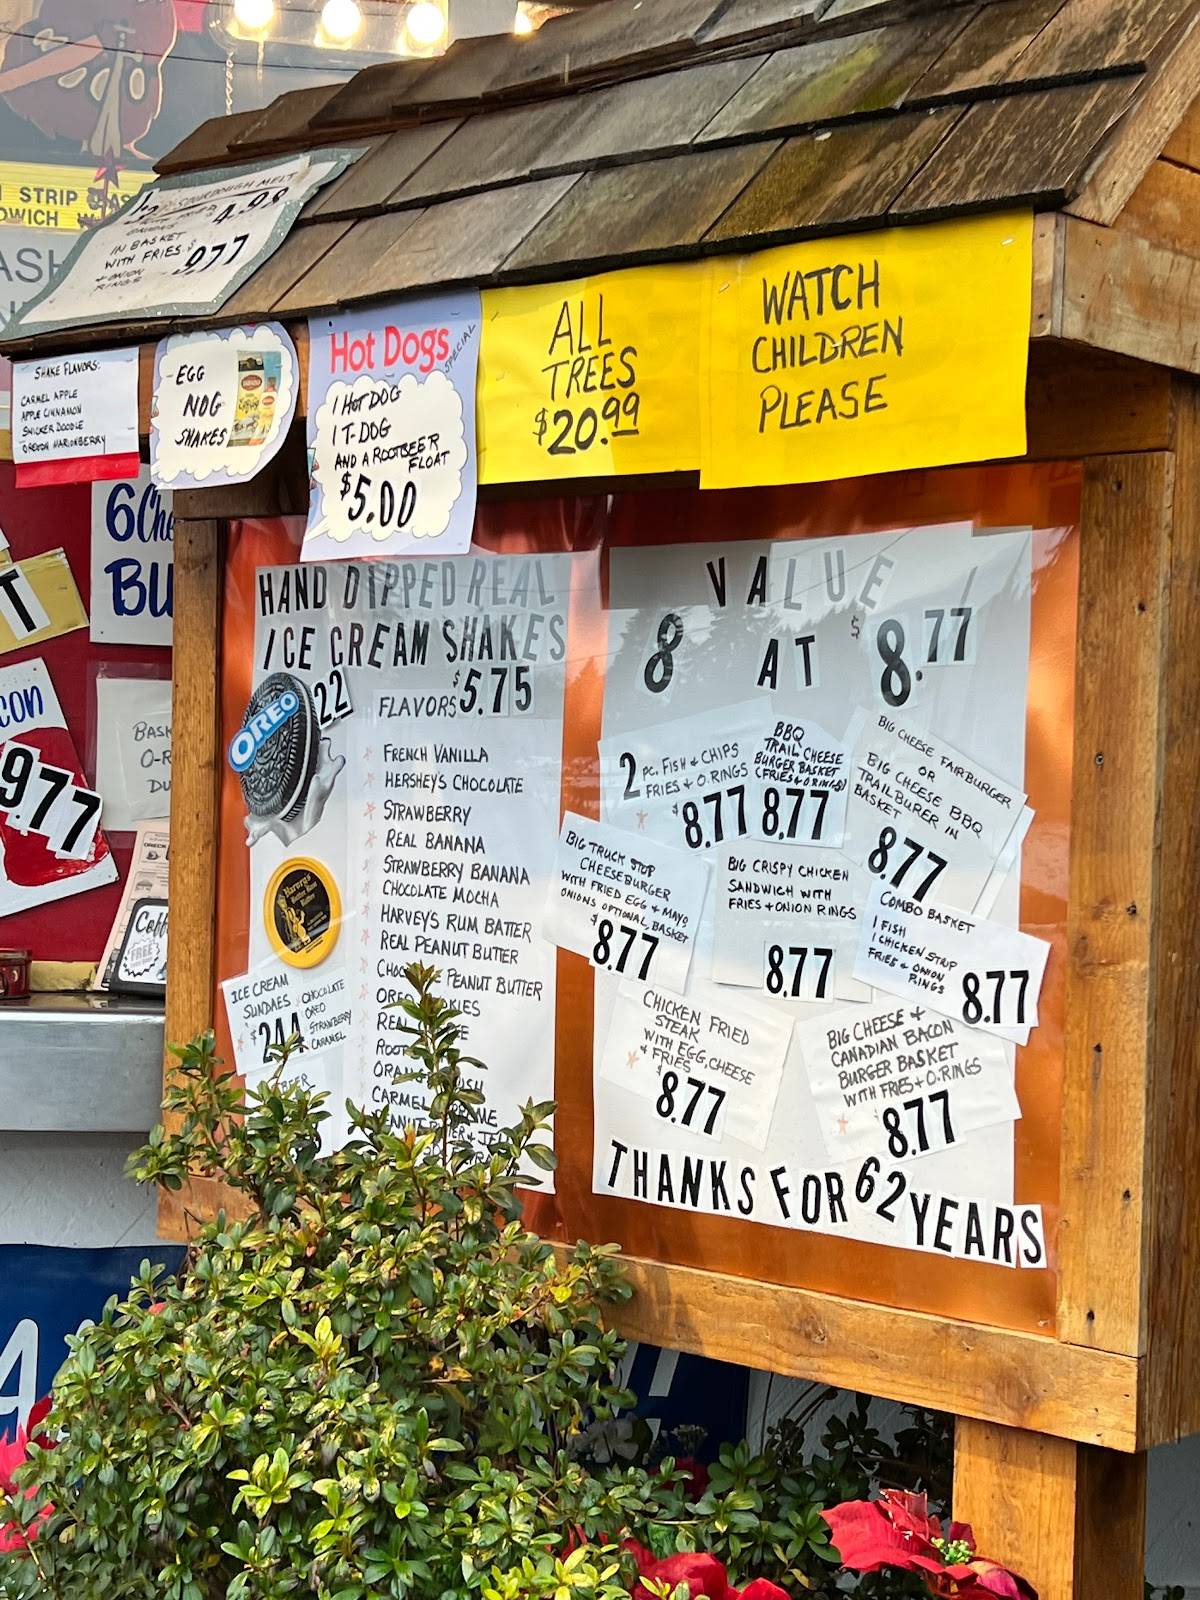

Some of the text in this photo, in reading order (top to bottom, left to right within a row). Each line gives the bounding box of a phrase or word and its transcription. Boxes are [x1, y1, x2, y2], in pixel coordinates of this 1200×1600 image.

[20, 187, 78, 206] STRIP
[105, 246, 181, 270] WITH FRIES
[110, 232, 187, 256] IN BASKET
[761, 260, 882, 327] WATCH
[548, 293, 613, 356] ALL
[330, 325, 450, 374] Hot Dogs
[444, 323, 477, 374] SPECIAL
[751, 315, 905, 373] CHILDREN
[34, 363, 61, 381] SHAKE
[175, 364, 205, 386] EGG
[541, 346, 639, 403] TREES
[54, 388, 79, 400] APPLE
[182, 390, 222, 417] NOG
[369, 384, 402, 408] DOG
[757, 374, 889, 433] PLEASE
[21, 404, 82, 421] APPLE CINNAMON
[56, 420, 84, 433] DOODLE
[532, 392, 642, 456] $20.99
[174, 427, 228, 448] SHAKES
[334, 453, 356, 471] AND
[361, 451, 369, 467] A
[408, 450, 451, 473] FLOAT
[105, 482, 136, 542] 6
[340, 470, 417, 528] $5.00
[258, 558, 556, 617] HAND DIPPED REAL
[706, 549, 895, 610] VALUE
[263, 614, 566, 671] ICE CREAM SHAKES
[644, 612, 684, 693] 8
[757, 634, 816, 691] AT
[378, 695, 457, 719] FLAVORS
[230, 692, 297, 766] OREO
[773, 721, 805, 749] BBQ
[384, 743, 489, 764] FRENCH VANILLA
[754, 751, 841, 778] BURGER BASKET
[764, 737, 844, 765] TRAIL CHEESE
[877, 715, 1013, 809] BIG CHEESE FAIRBURGER
[385, 771, 524, 795] HERSHEY'S CHOCOLATE
[619, 742, 740, 800] 2 FISH CHIPS
[918, 765, 936, 783] OR
[646, 780, 681, 799] FRIES
[853, 784, 903, 820] BASKET
[866, 751, 984, 839] BIG CHEESE BBQ
[384, 799, 472, 826] STRAWBERRY
[762, 787, 830, 842] 8.77
[386, 828, 486, 855] REAL BANANA
[944, 826, 960, 840] IN
[566, 830, 656, 878] BIG TRUCK STOP
[728, 856, 849, 882] BIG CRISPY CHICKEN
[868, 826, 948, 903] 8.77
[383, 854, 531, 886] STRAWBERRY BANANA
[580, 856, 672, 902] CHEESEBURGER
[382, 879, 500, 909] CHOCOLATE MOCHA
[561, 870, 648, 910] WITH FRIED EGG
[728, 879, 832, 901] SANDWICH WITH
[381, 903, 533, 943] HARVEY'S RUM BATTER
[560, 887, 690, 944] ONIONS BASKET
[728, 898, 762, 910] FRIES
[817, 904, 857, 919] RINGS
[880, 891, 976, 934] COMBO BASKET
[881, 920, 907, 938] FISH
[380, 929, 519, 965] REAL PEANUT BUTTER
[879, 934, 958, 972] CHICKEN STRIP
[446, 967, 492, 991] PEANUT
[496, 975, 544, 1002] BUTTER
[766, 944, 833, 999] 8.77
[908, 973, 945, 995] RINGS
[912, 963, 945, 982] ONION
[231, 973, 289, 1004] ICE CREAM
[301, 979, 346, 1005] CHOCOLATE
[962, 970, 1029, 1025] 8.77
[243, 994, 292, 1020] SUNDAES
[305, 1002, 327, 1020] OREO
[310, 1009, 352, 1035] STRAWBERRY
[643, 990, 750, 1046] CHICKEN FRIED
[644, 1027, 673, 1049] WITH
[655, 1014, 700, 1044] STEAK
[827, 1008, 905, 1050] BIG CHEESE
[831, 1019, 954, 1068] CANADIAN BACON
[652, 1047, 692, 1074] FRIES
[838, 1041, 959, 1090] BURGER BASKET
[843, 1077, 914, 1108] WITH FRIES
[607, 1139, 1043, 1265] THANKS FOR 62 YEARS
